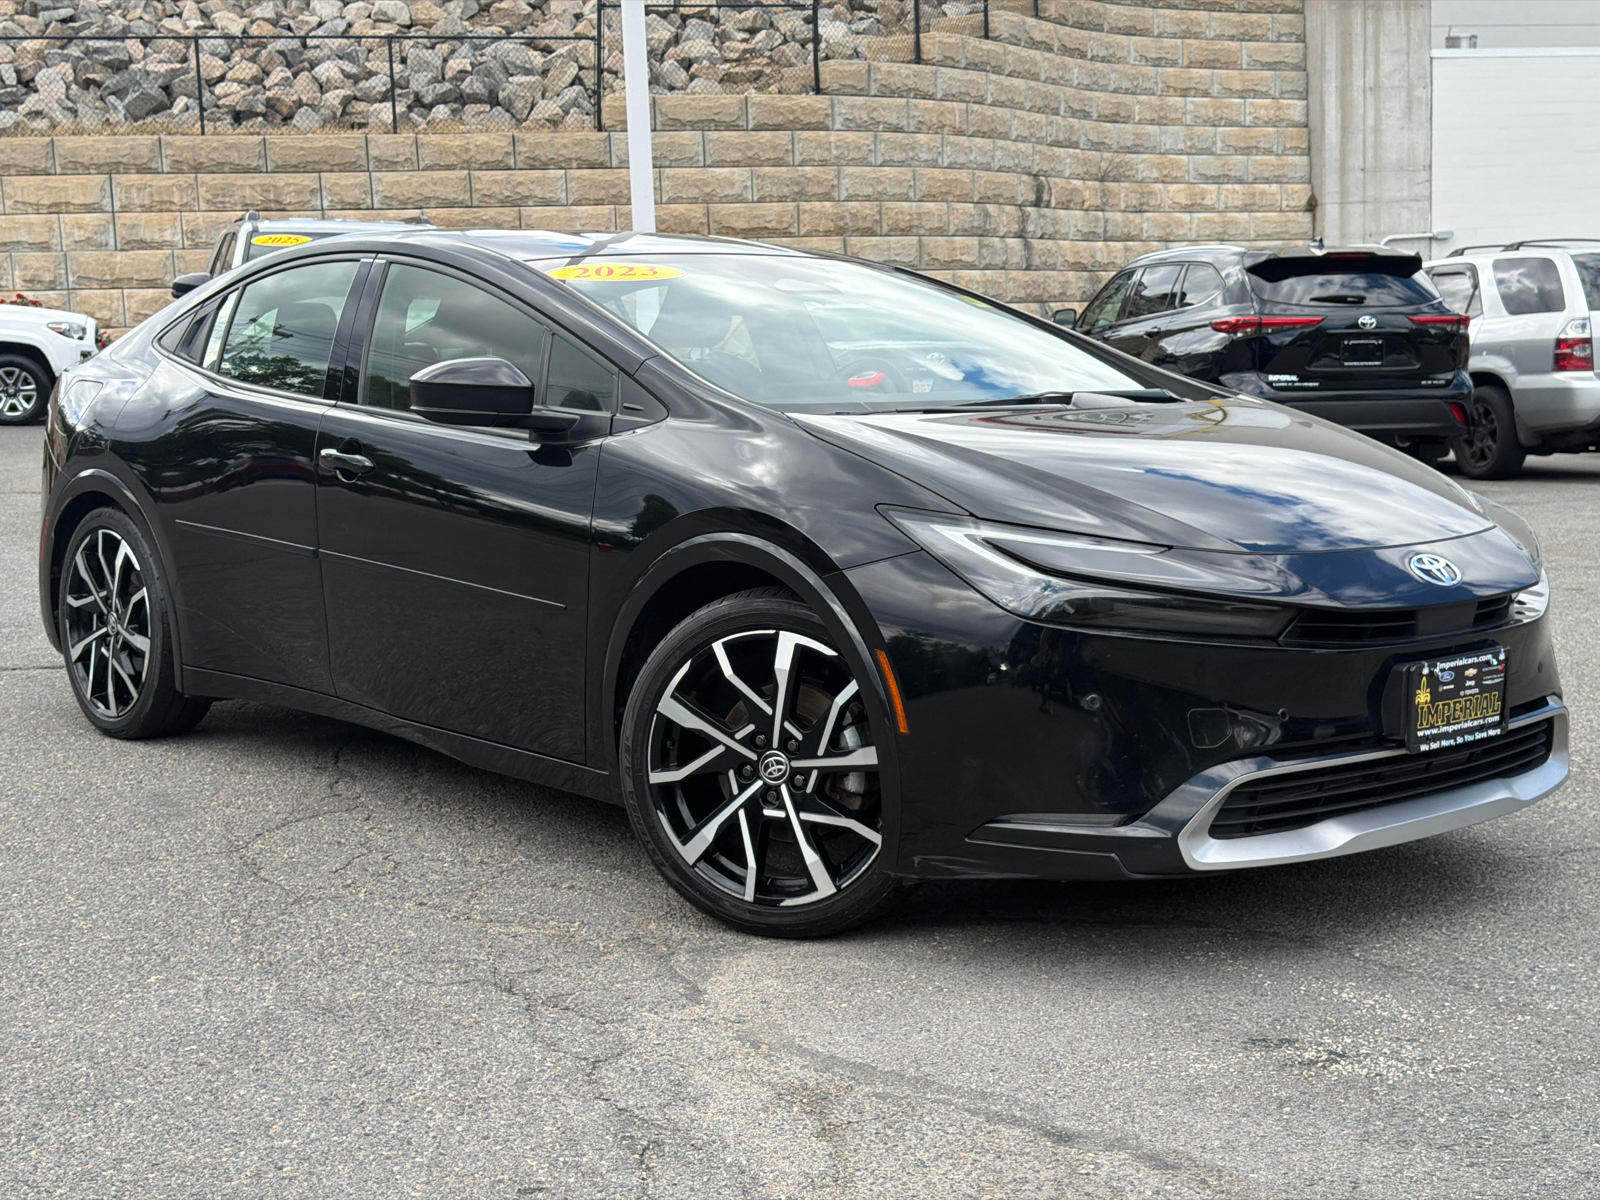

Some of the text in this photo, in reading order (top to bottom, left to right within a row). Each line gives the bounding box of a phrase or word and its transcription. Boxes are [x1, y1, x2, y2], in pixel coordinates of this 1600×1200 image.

[262, 236, 303, 244] 2025
[573, 265, 659, 279] 2023
[1417, 691, 1501, 729] IMPERIAL
[1417, 715, 1500, 737] www.imperialcars.com
[1420, 728, 1501, 752] We Sell More, So You Save More
